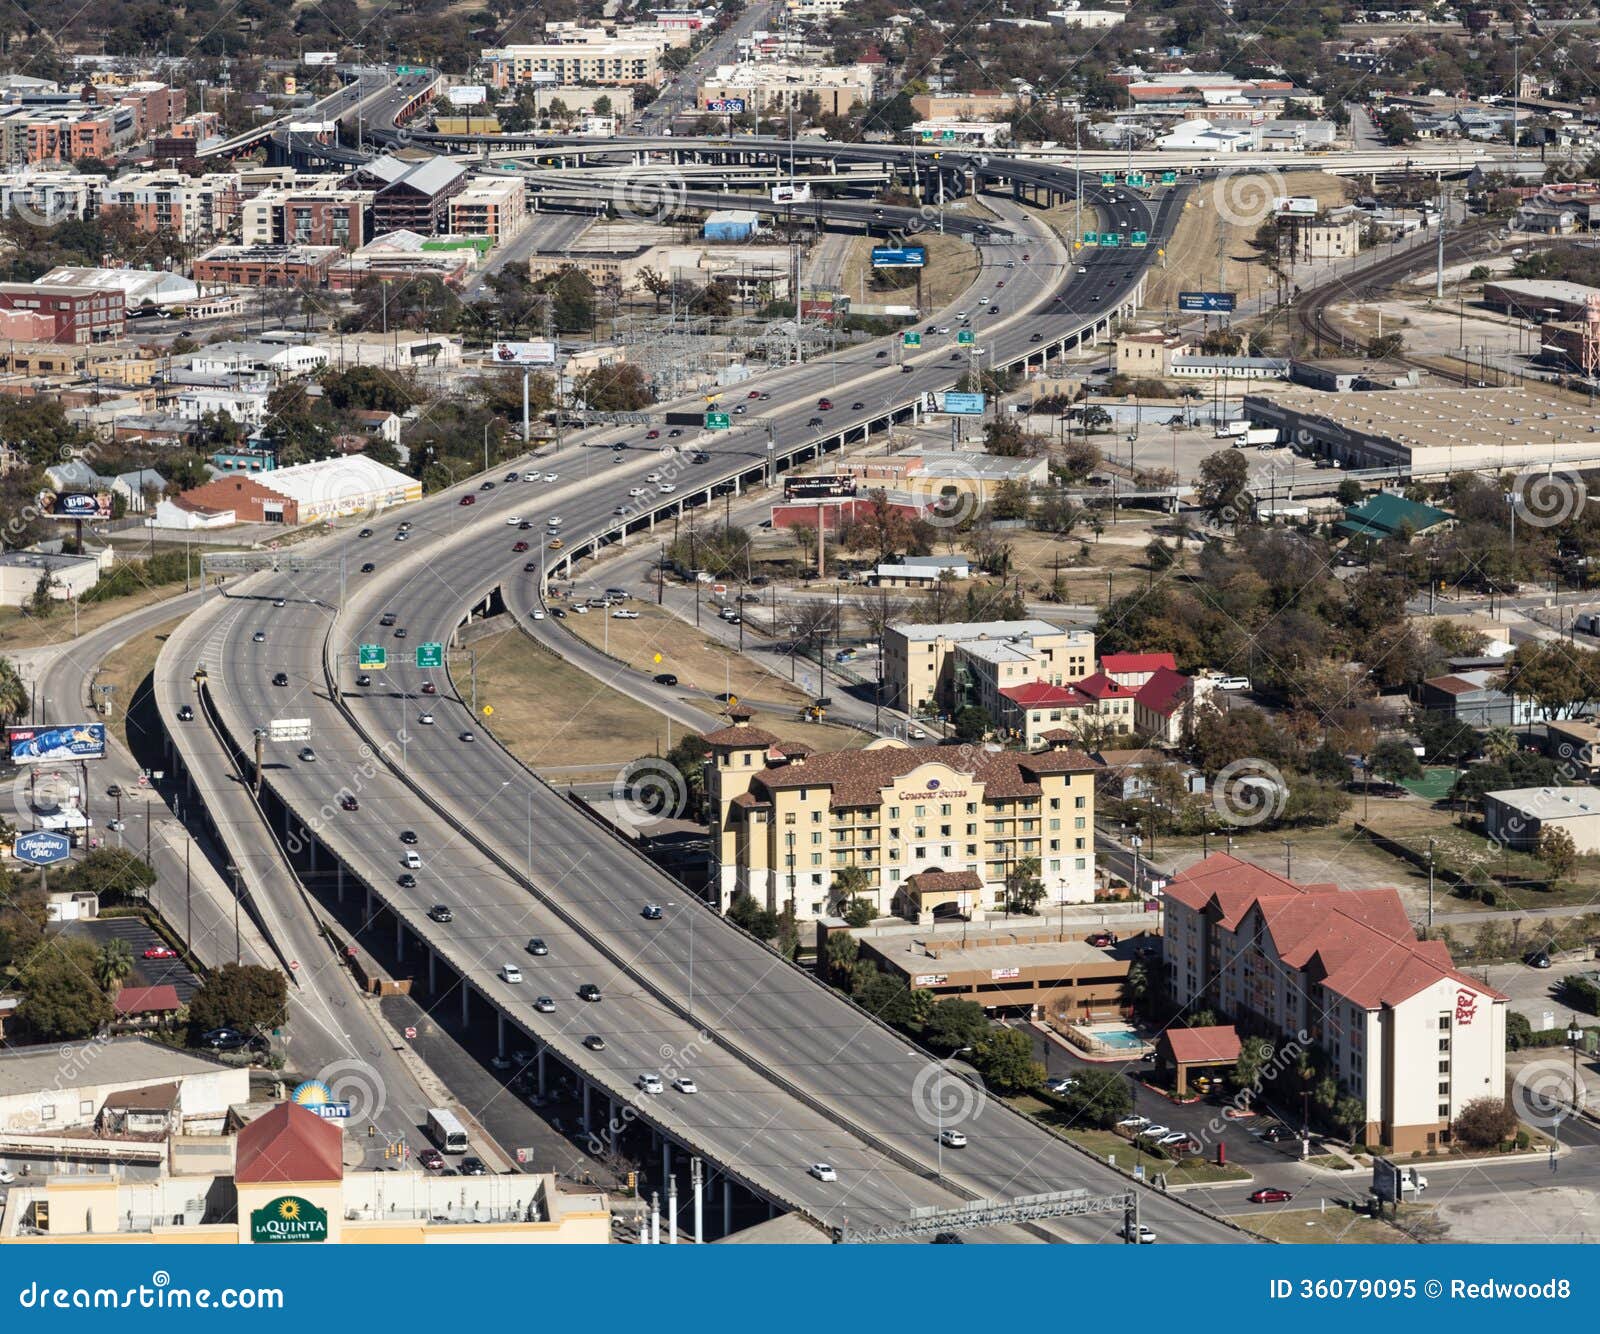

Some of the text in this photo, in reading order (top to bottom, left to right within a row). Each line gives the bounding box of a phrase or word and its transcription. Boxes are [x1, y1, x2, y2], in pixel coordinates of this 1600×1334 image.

[21, 839, 62, 852] Hampton
[31, 848, 52, 858] Inn
[1457, 995, 1474, 1006] Red
[320, 1104, 347, 1117] Inn
